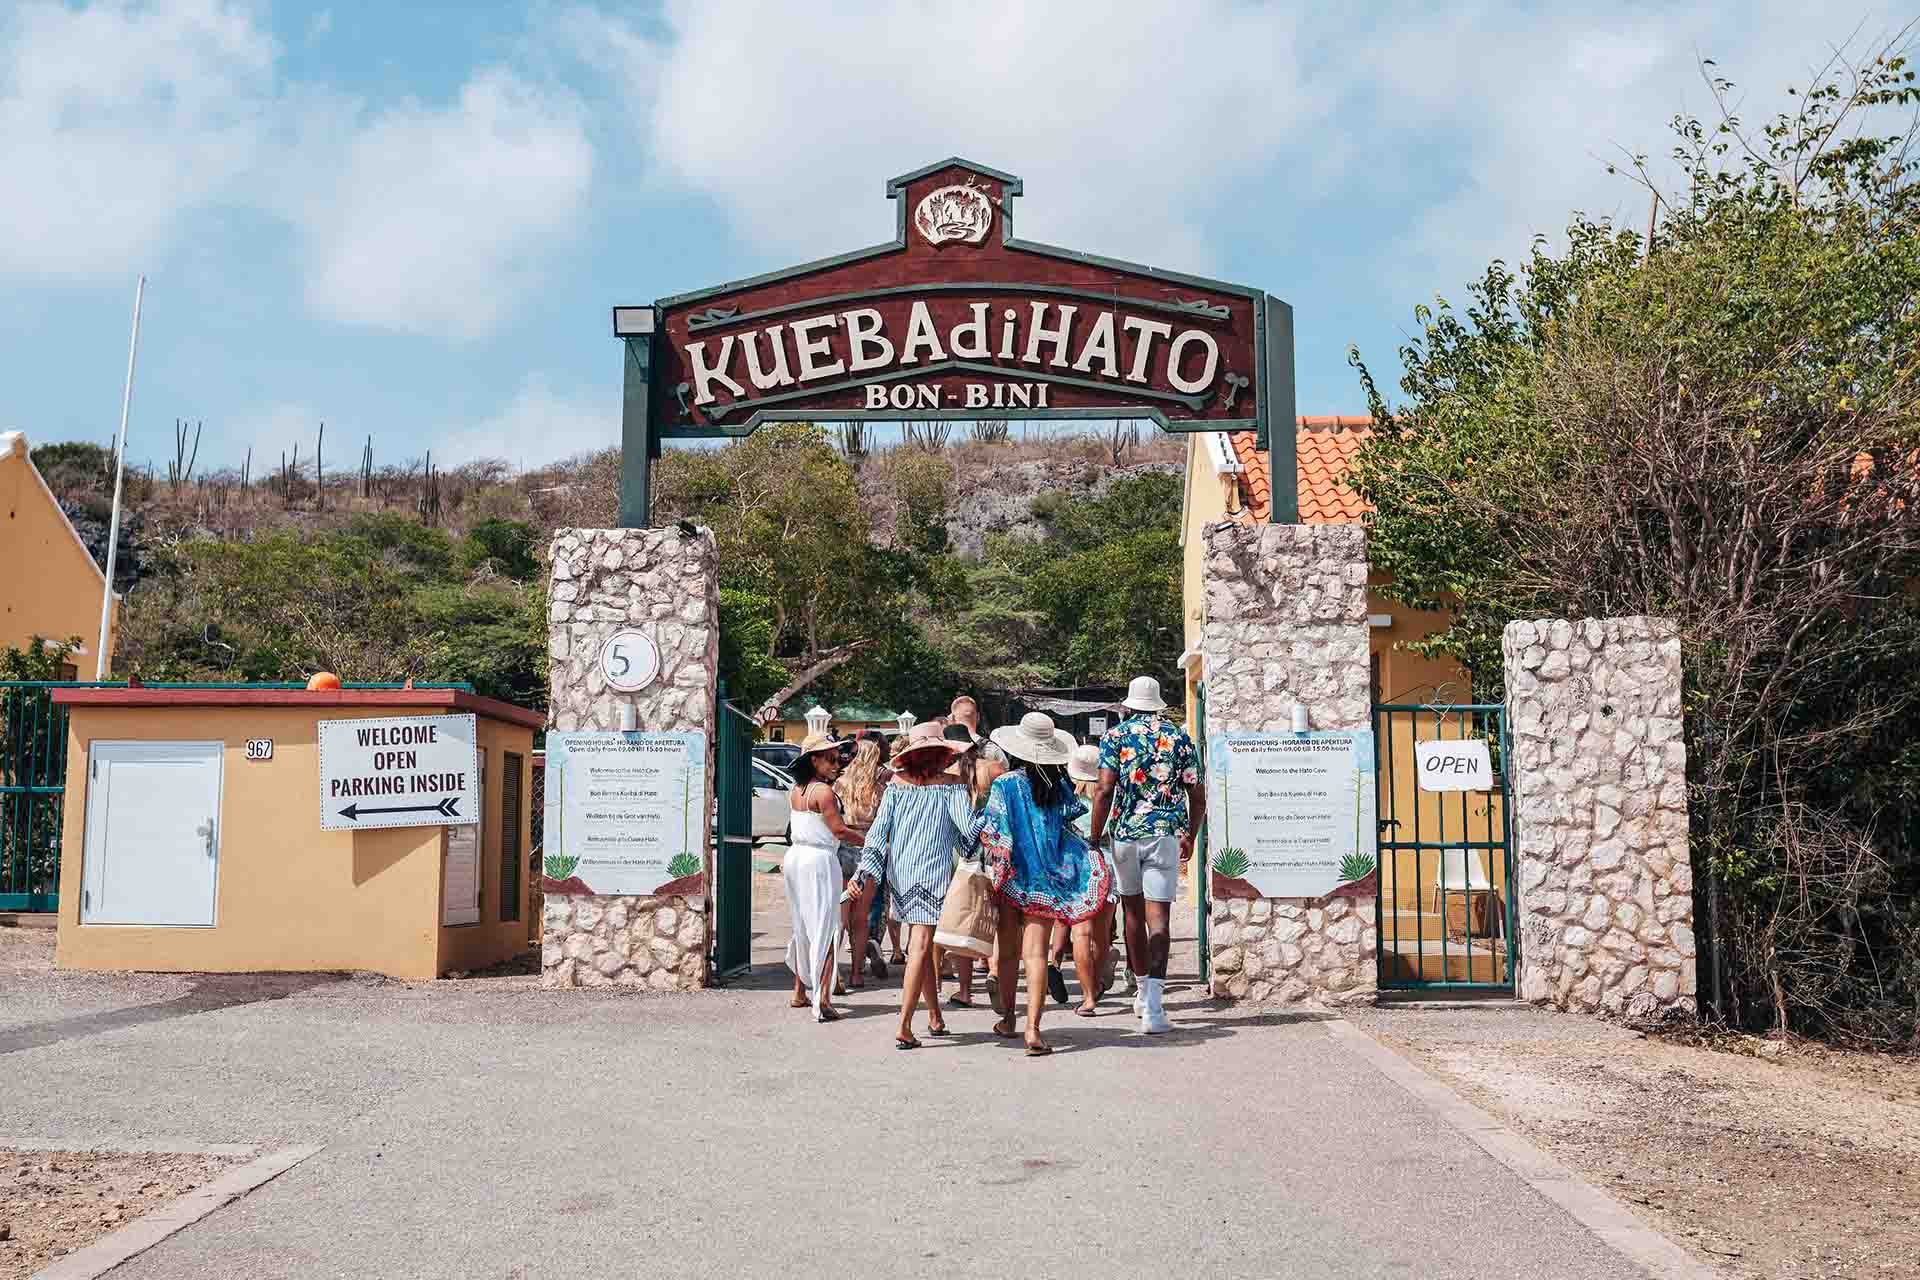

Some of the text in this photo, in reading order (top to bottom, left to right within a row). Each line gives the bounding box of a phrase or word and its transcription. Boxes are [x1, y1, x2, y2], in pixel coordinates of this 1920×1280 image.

[864, 383, 941, 409] BON
[964, 382, 1048, 408] BINI
[610, 644, 631, 677] 5
[357, 725, 437, 747] WELCOME
[248, 741, 270, 757] 967
[374, 751, 417, 770] OPEN
[1425, 755, 1478, 775] OPEN
[331, 773, 465, 797] PARKING INSIDE
